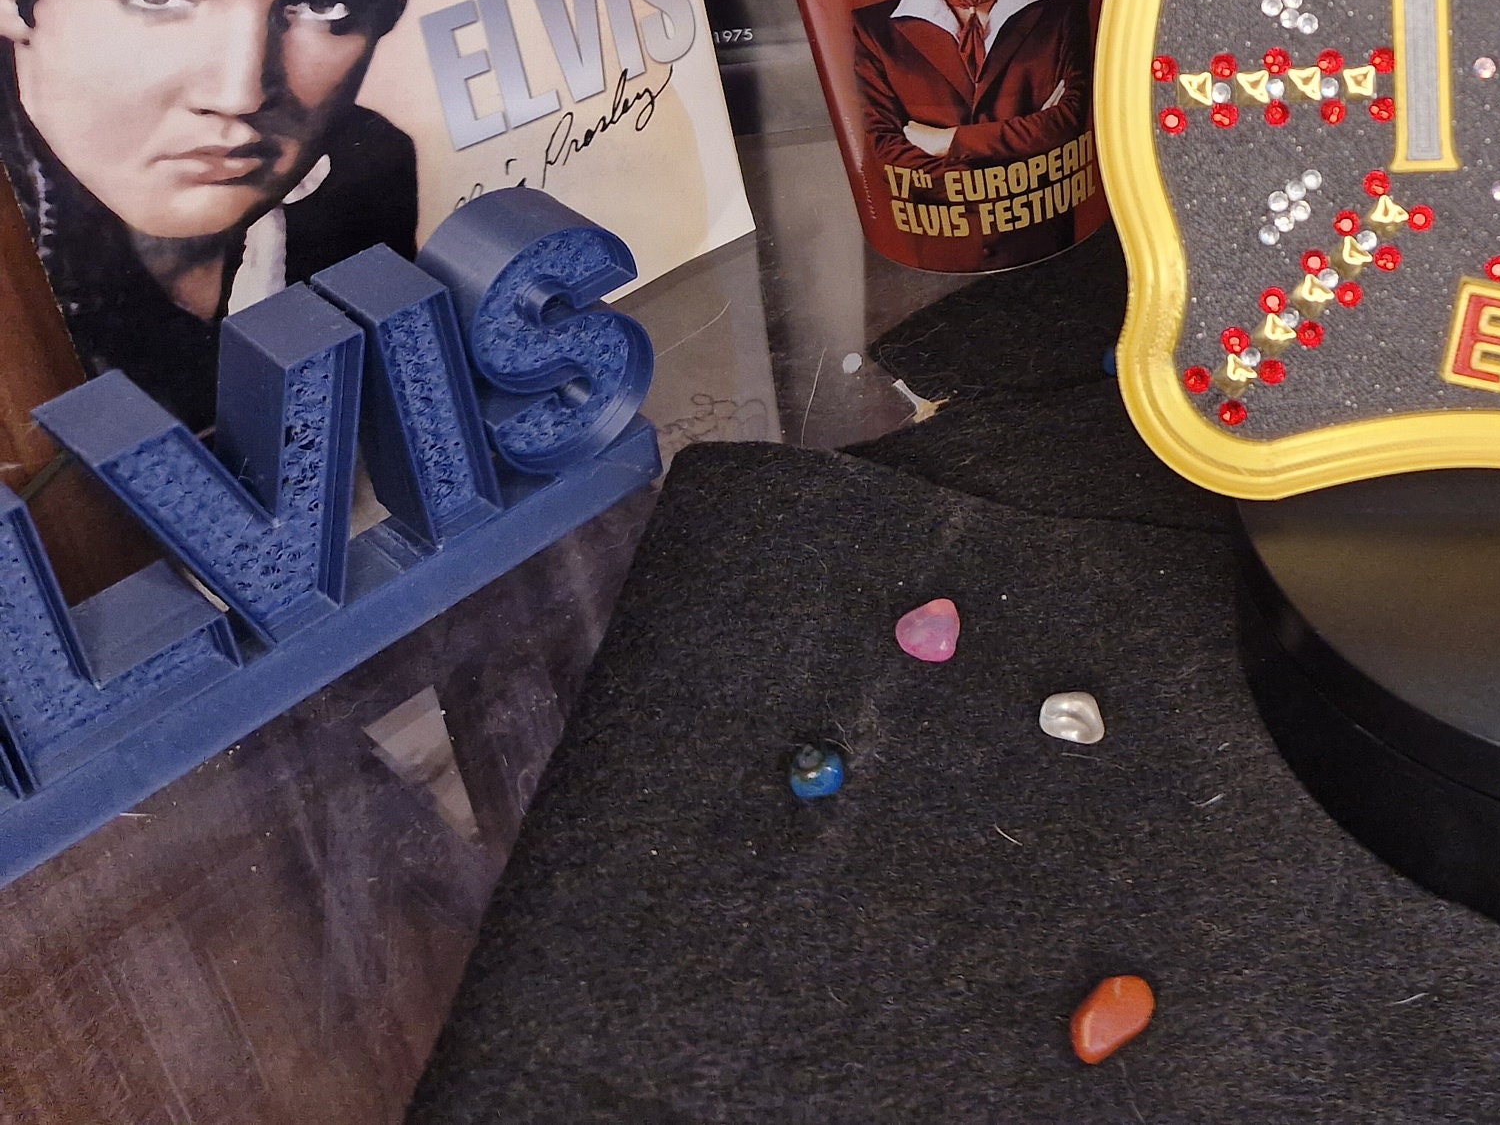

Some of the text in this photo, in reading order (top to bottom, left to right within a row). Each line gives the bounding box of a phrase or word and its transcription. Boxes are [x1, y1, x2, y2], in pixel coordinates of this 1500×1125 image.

[713, 27, 753, 43] 1975
[884, 164, 933, 199] 17th
[944, 130, 1093, 202] EUROPEAN
[891, 165, 1096, 237] ELVIS FESTIVAL
[0, 186, 655, 800] LVIS
